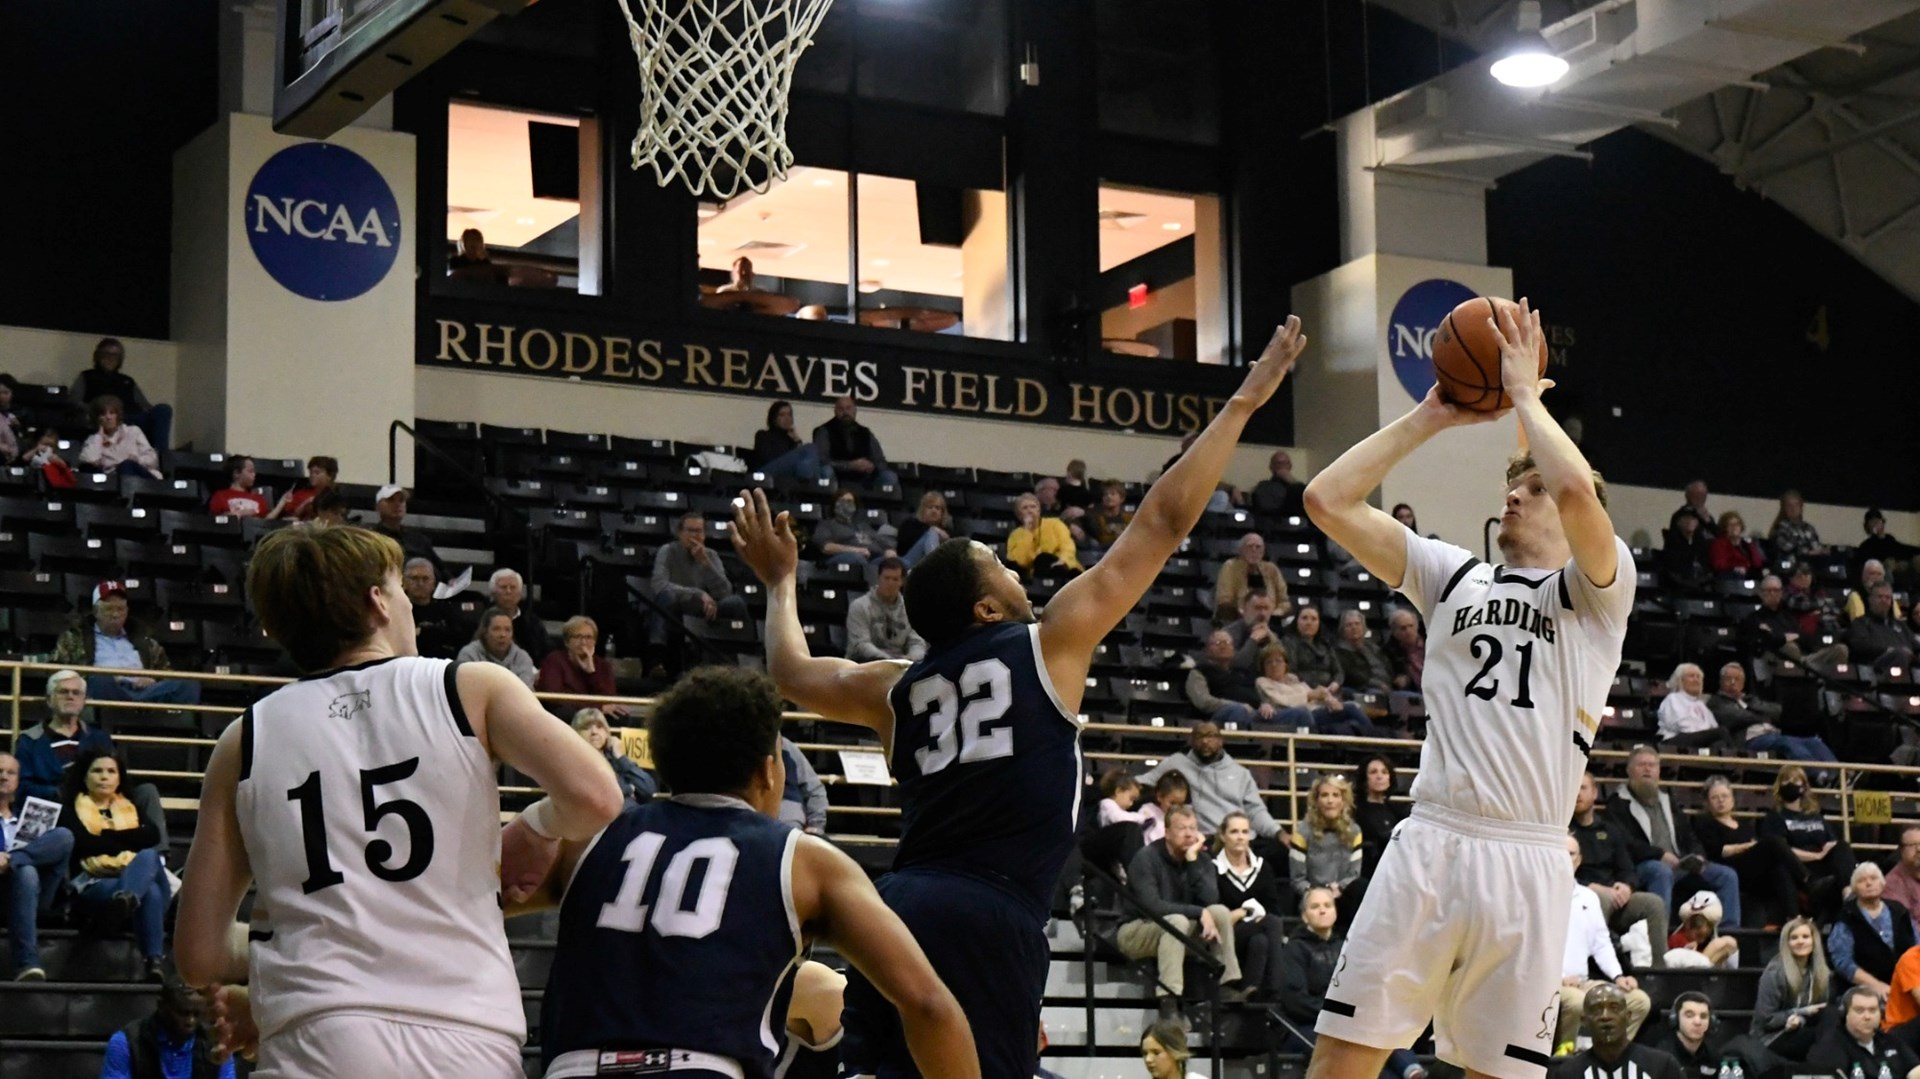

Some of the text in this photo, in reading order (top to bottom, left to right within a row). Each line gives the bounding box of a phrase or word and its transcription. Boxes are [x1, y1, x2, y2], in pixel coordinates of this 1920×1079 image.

[253, 194, 392, 247] NCAA
[436, 319, 879, 401] RHODES-REAVES
[902, 365, 1048, 416] FIELD
[1451, 598, 1556, 645] HARDING
[1464, 634, 1535, 709] 21
[909, 657, 1014, 776] 32
[287, 756, 435, 895] 15
[1856, 796, 1889, 817] HOME
[596, 831, 740, 939] 10
